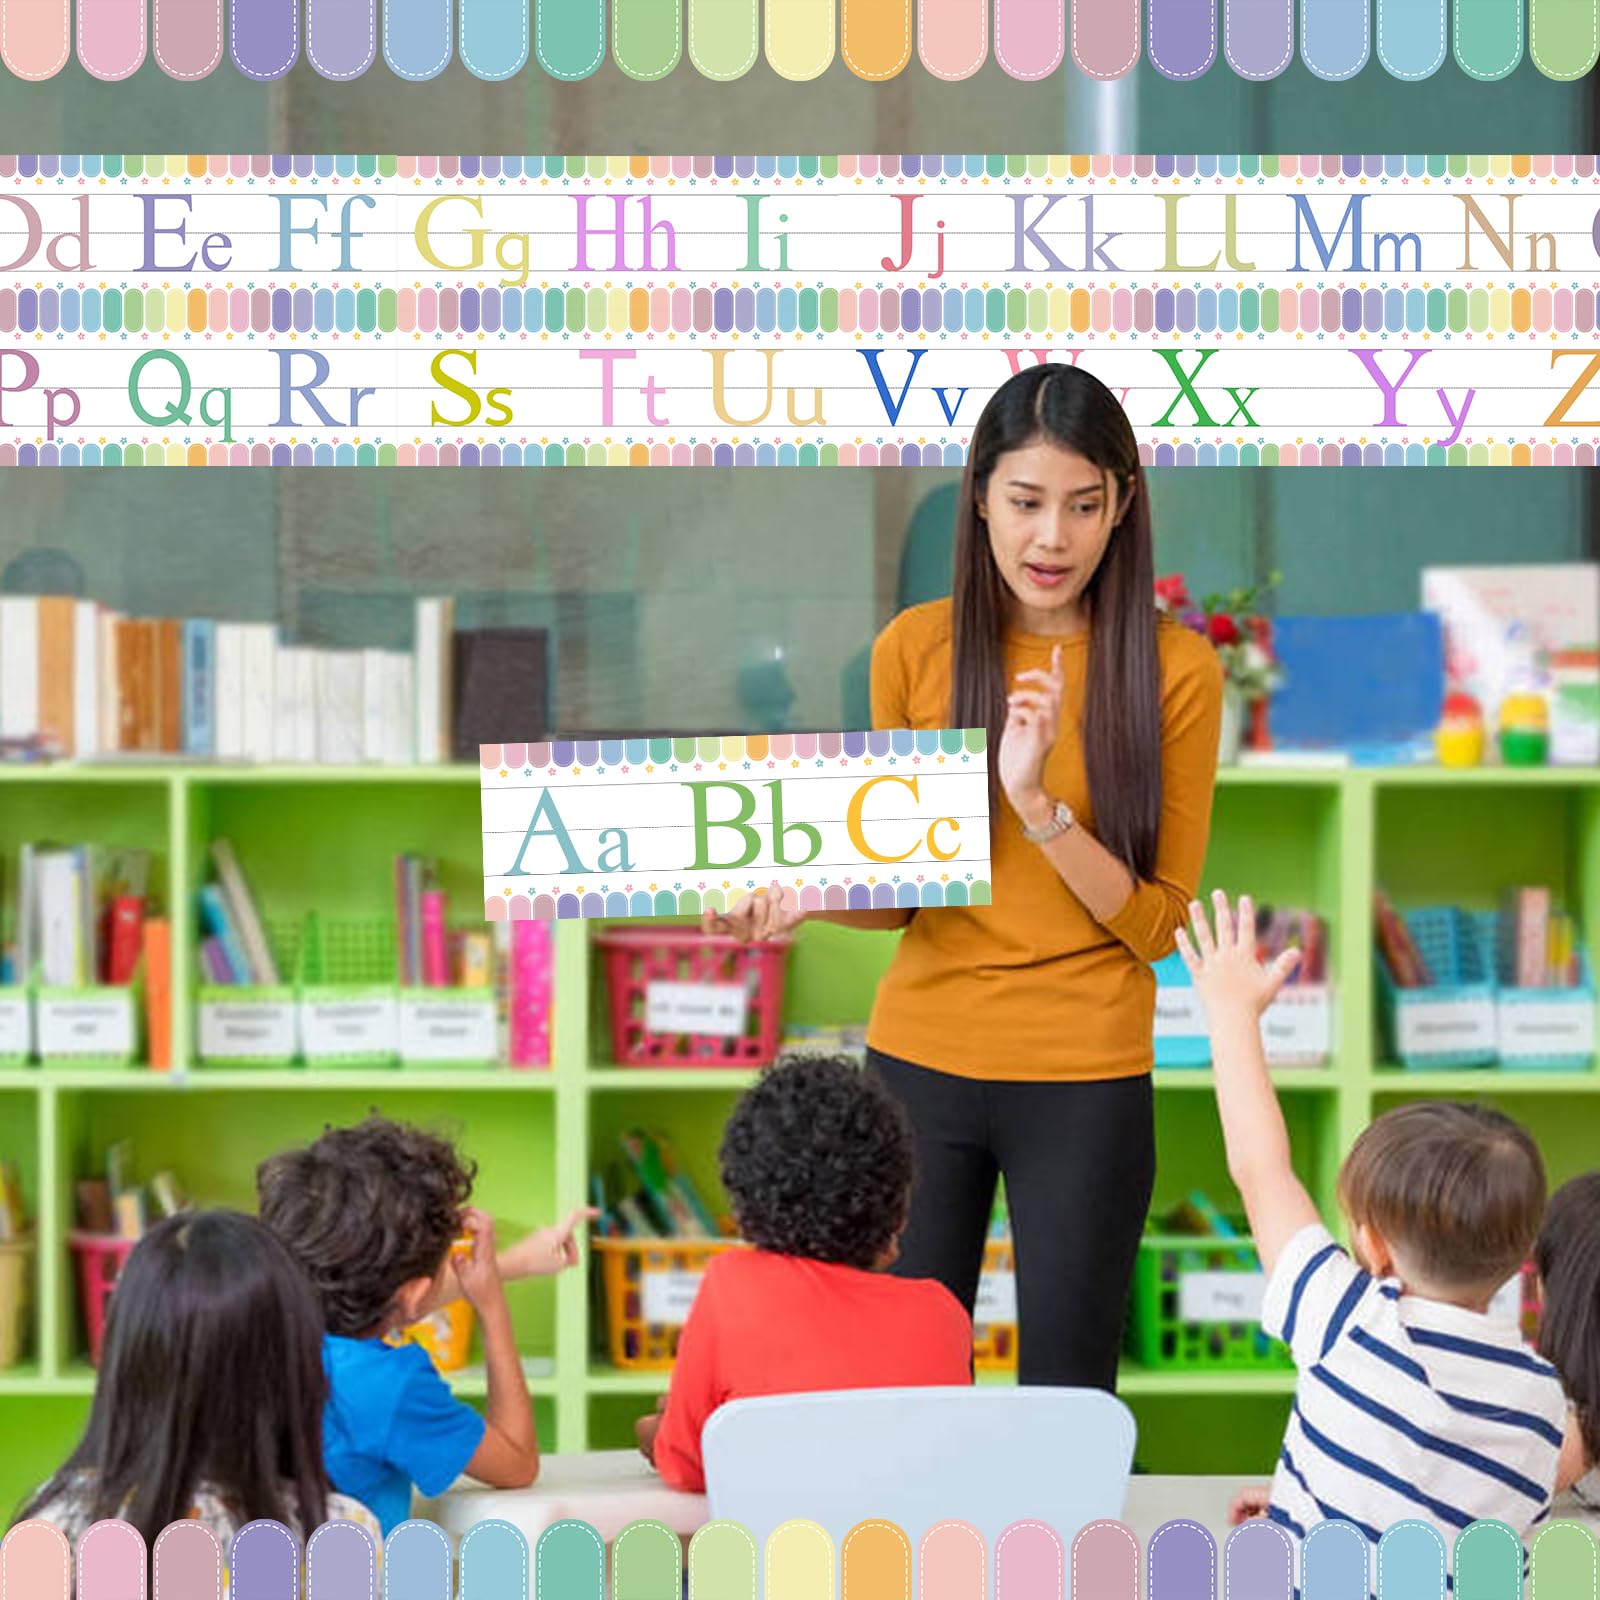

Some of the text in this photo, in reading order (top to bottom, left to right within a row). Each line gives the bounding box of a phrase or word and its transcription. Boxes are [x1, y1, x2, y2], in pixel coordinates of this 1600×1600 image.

[133, 194, 233, 272] Ee
[269, 194, 377, 272] Ff
[413, 193, 532, 287] Gg
[567, 194, 680, 272] Hh
[735, 194, 790, 272] Ii
[880, 194, 946, 279] Jj
[1005, 194, 1126, 272] Kk
[1154, 194, 1257, 272] Ll
[1286, 194, 1423, 272] Mm
[1452, 194, 1561, 272] Nn
[0, 349, 81, 441] Pp
[127, 349, 237, 443] Qq
[268, 349, 376, 427] Rr
[429, 348, 514, 427] Ss
[579, 349, 670, 427] Tt
[702, 348, 828, 427] Uu
[855, 348, 970, 427] Vv
[1150, 348, 1262, 427] Xx
[1347, 348, 1476, 447] Yy
[1542, 349, 1600, 427] Z
[503, 775, 963, 876] Aa Bb Cc
